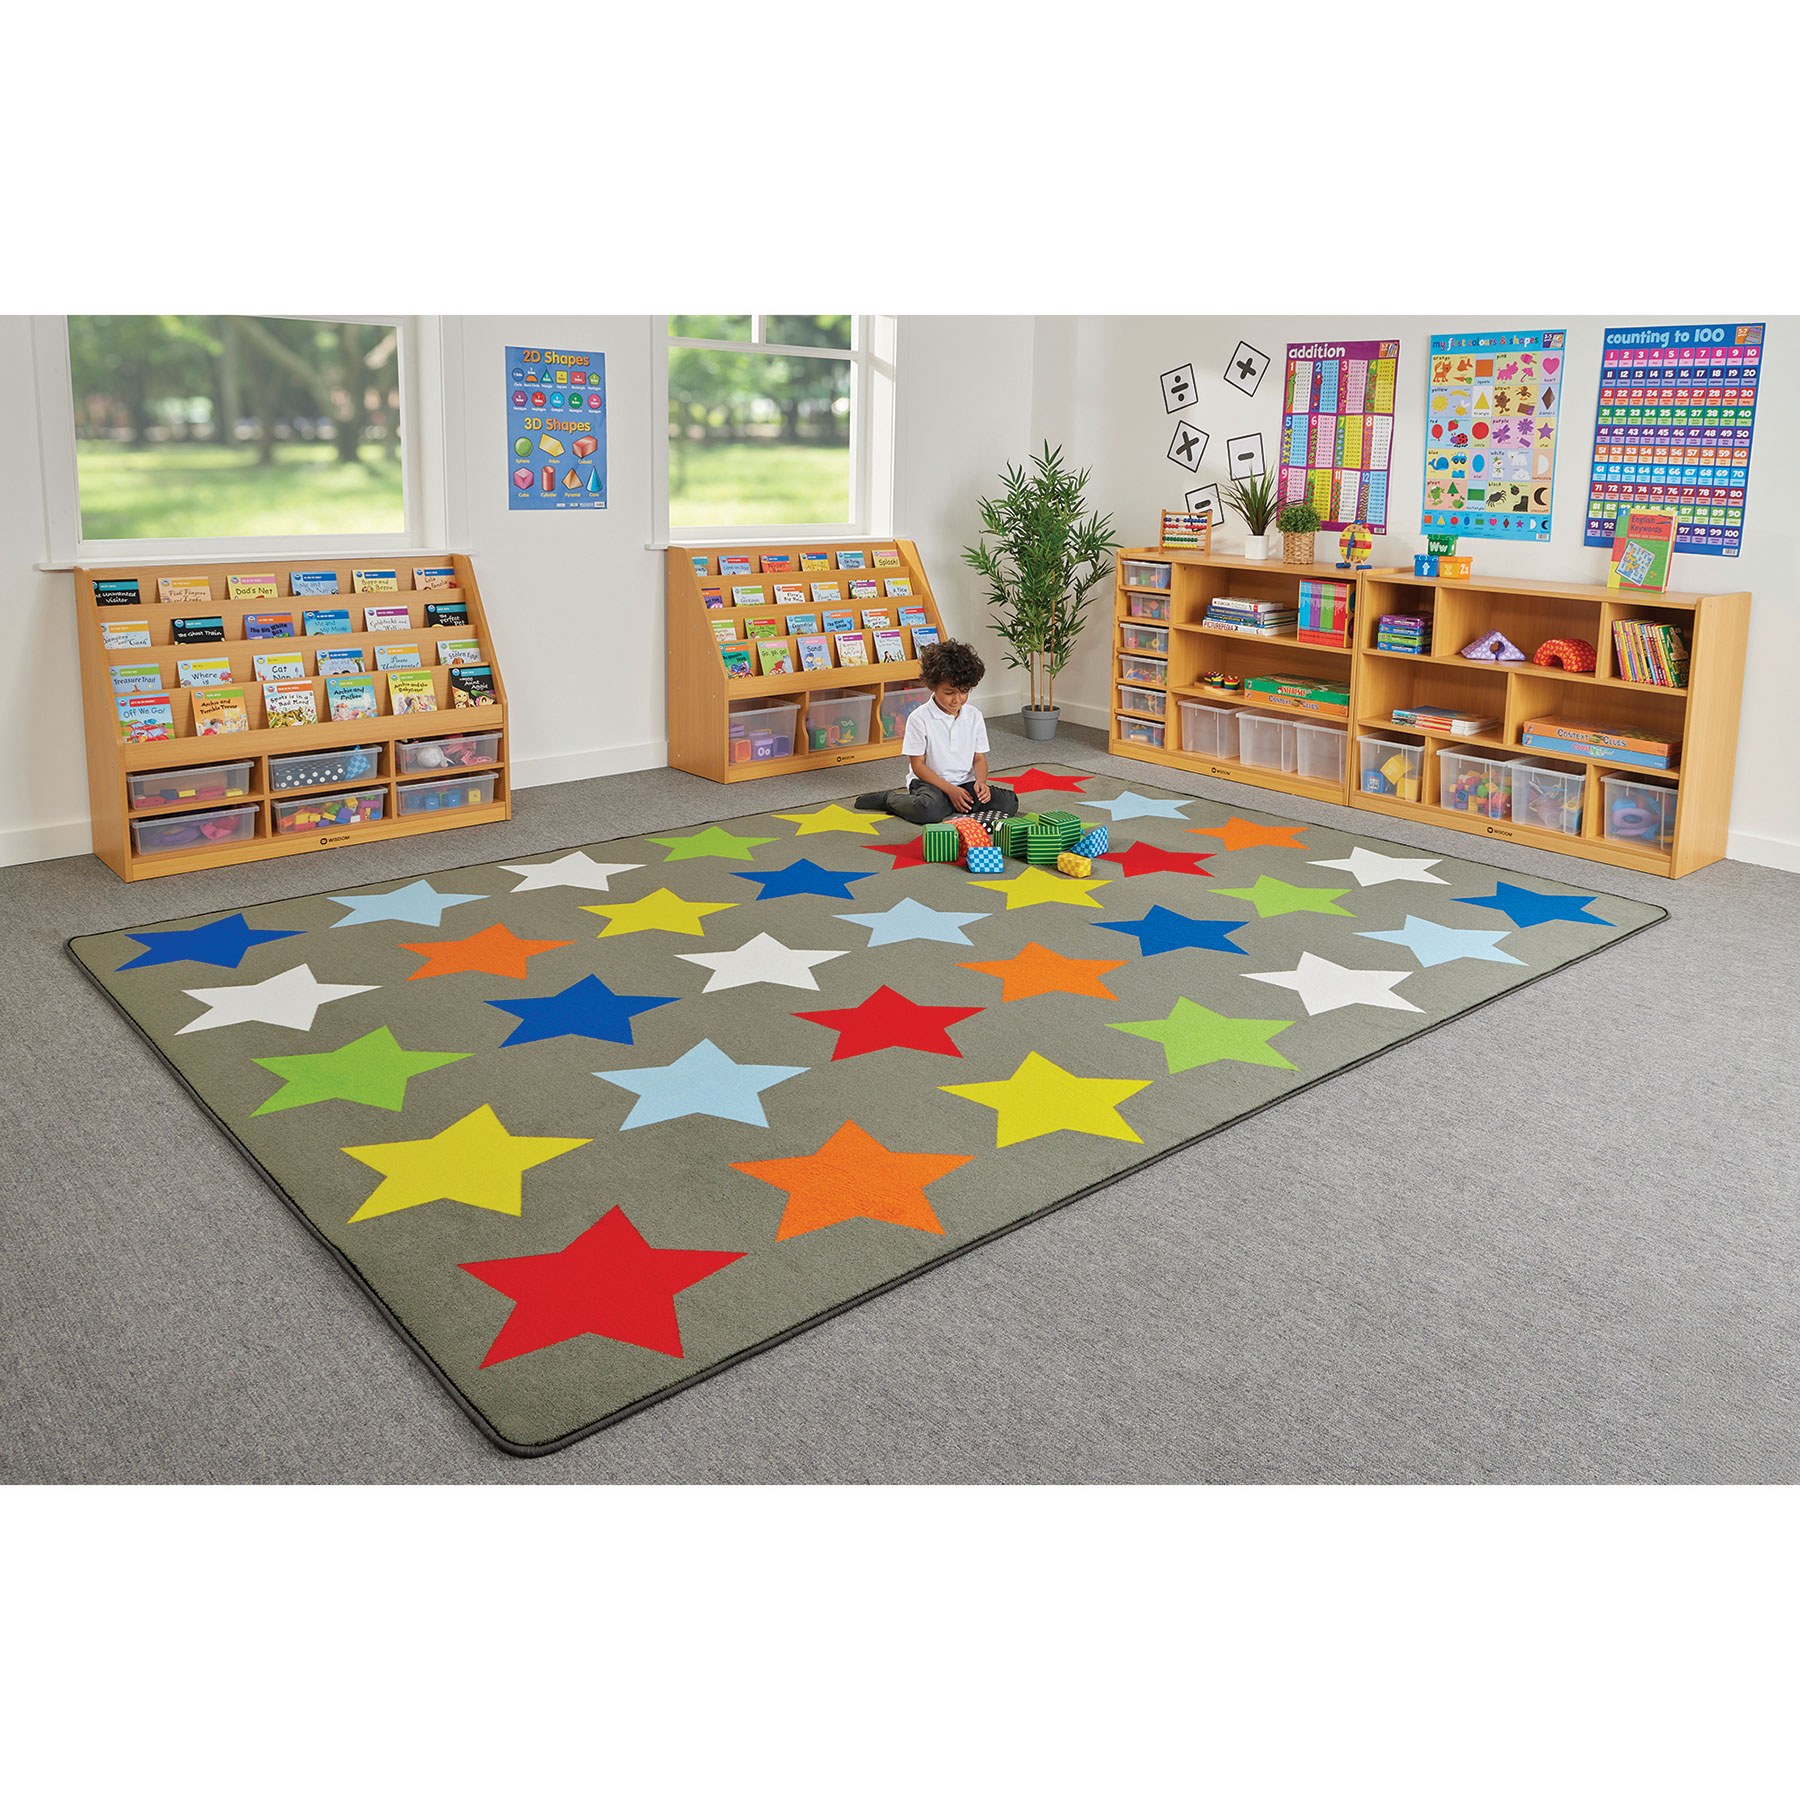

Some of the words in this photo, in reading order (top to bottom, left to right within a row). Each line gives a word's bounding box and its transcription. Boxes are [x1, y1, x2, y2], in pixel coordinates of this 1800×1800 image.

[1433, 341, 1445, 351] my
[1447, 338, 1466, 351] first
[1468, 338, 1497, 346] colours
[1500, 336, 1506, 344] &
[1509, 335, 1539, 348] shapes
[1606, 330, 1670, 348] counting
[1674, 330, 1690, 343] to
[1694, 328, 1724, 342] 100
[1288, 344, 1346, 358] addition
[523, 350, 541, 363] 2D
[544, 351, 590, 368] Shapes
[1290, 362, 1294, 371] 1
[1315, 363, 1322, 371] 2
[1342, 361, 1348, 370] 3
[1369, 361, 1376, 370] 4
[524, 417, 542, 430] 3D
[545, 417, 591, 434] Shapes
[1286, 417, 1292, 426] 5
[1311, 416, 1317, 425] 6
[1339, 417, 1345, 427] 7
[1366, 416, 1373, 426] 8
[1281, 468, 1288, 478] 9
[1308, 470, 1315, 479] 10
[1335, 470, 1340, 480] 11
[1362, 472, 1370, 482] 12
[1631, 515, 1655, 524] English
[1630, 525, 1662, 533] Keywords
[123, 708, 137, 718] Off
[1603, 735, 1627, 748] CLUES
